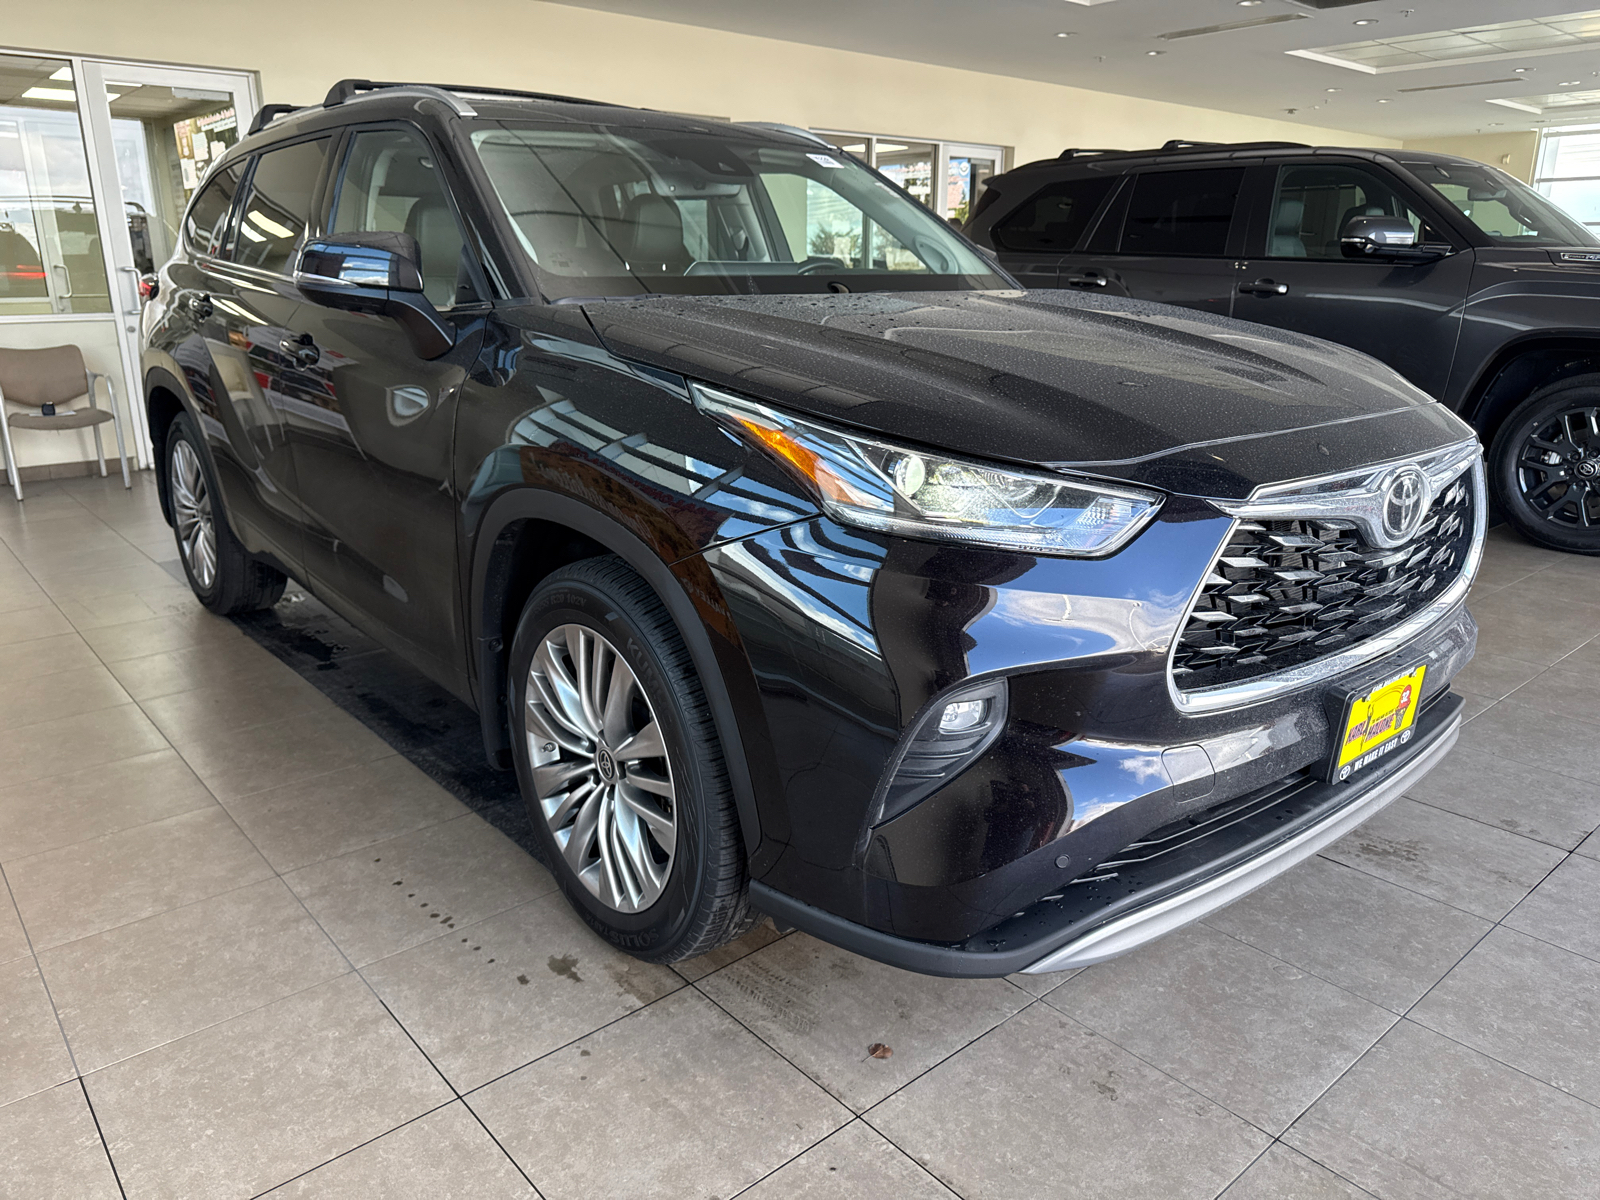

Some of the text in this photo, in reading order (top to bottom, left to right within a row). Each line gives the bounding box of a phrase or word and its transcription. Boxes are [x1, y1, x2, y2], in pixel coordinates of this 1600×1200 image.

[1345, 719, 1367, 746] KARL
[1364, 713, 1396, 743] MALONE
[1354, 738, 1399, 771] WE MAKE IT EASY
[609, 928, 659, 947] SOLUS
